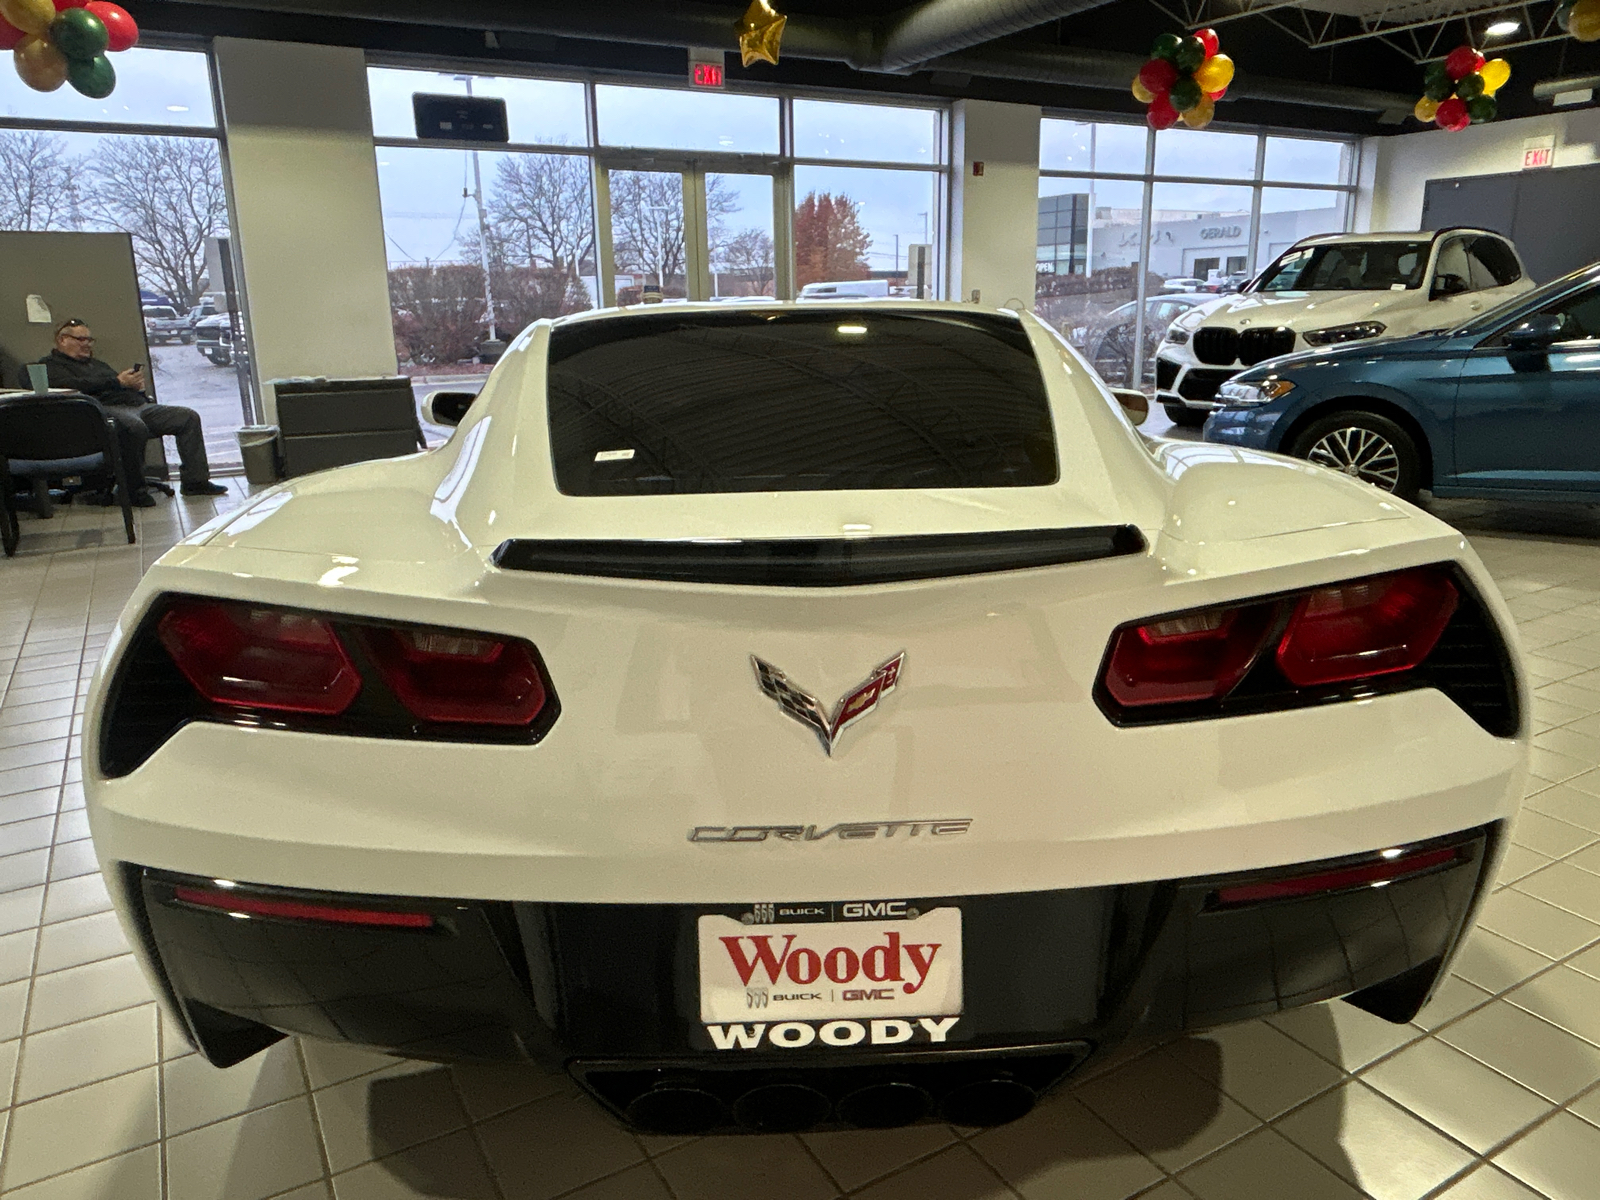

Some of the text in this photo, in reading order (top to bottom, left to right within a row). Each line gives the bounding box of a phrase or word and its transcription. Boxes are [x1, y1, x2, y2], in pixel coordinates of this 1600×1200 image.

[694, 63, 722, 86] EXIT
[1525, 149, 1551, 166] EXIT
[1200, 226, 1241, 240] GERALD
[1035, 262, 1055, 273] OPEN
[687, 818, 974, 843] CORVETTE
[779, 901, 907, 918] BUICK GMC
[718, 931, 942, 994] Woody
[772, 988, 895, 1001] BUICK GMC
[707, 1017, 960, 1050] WOODY
